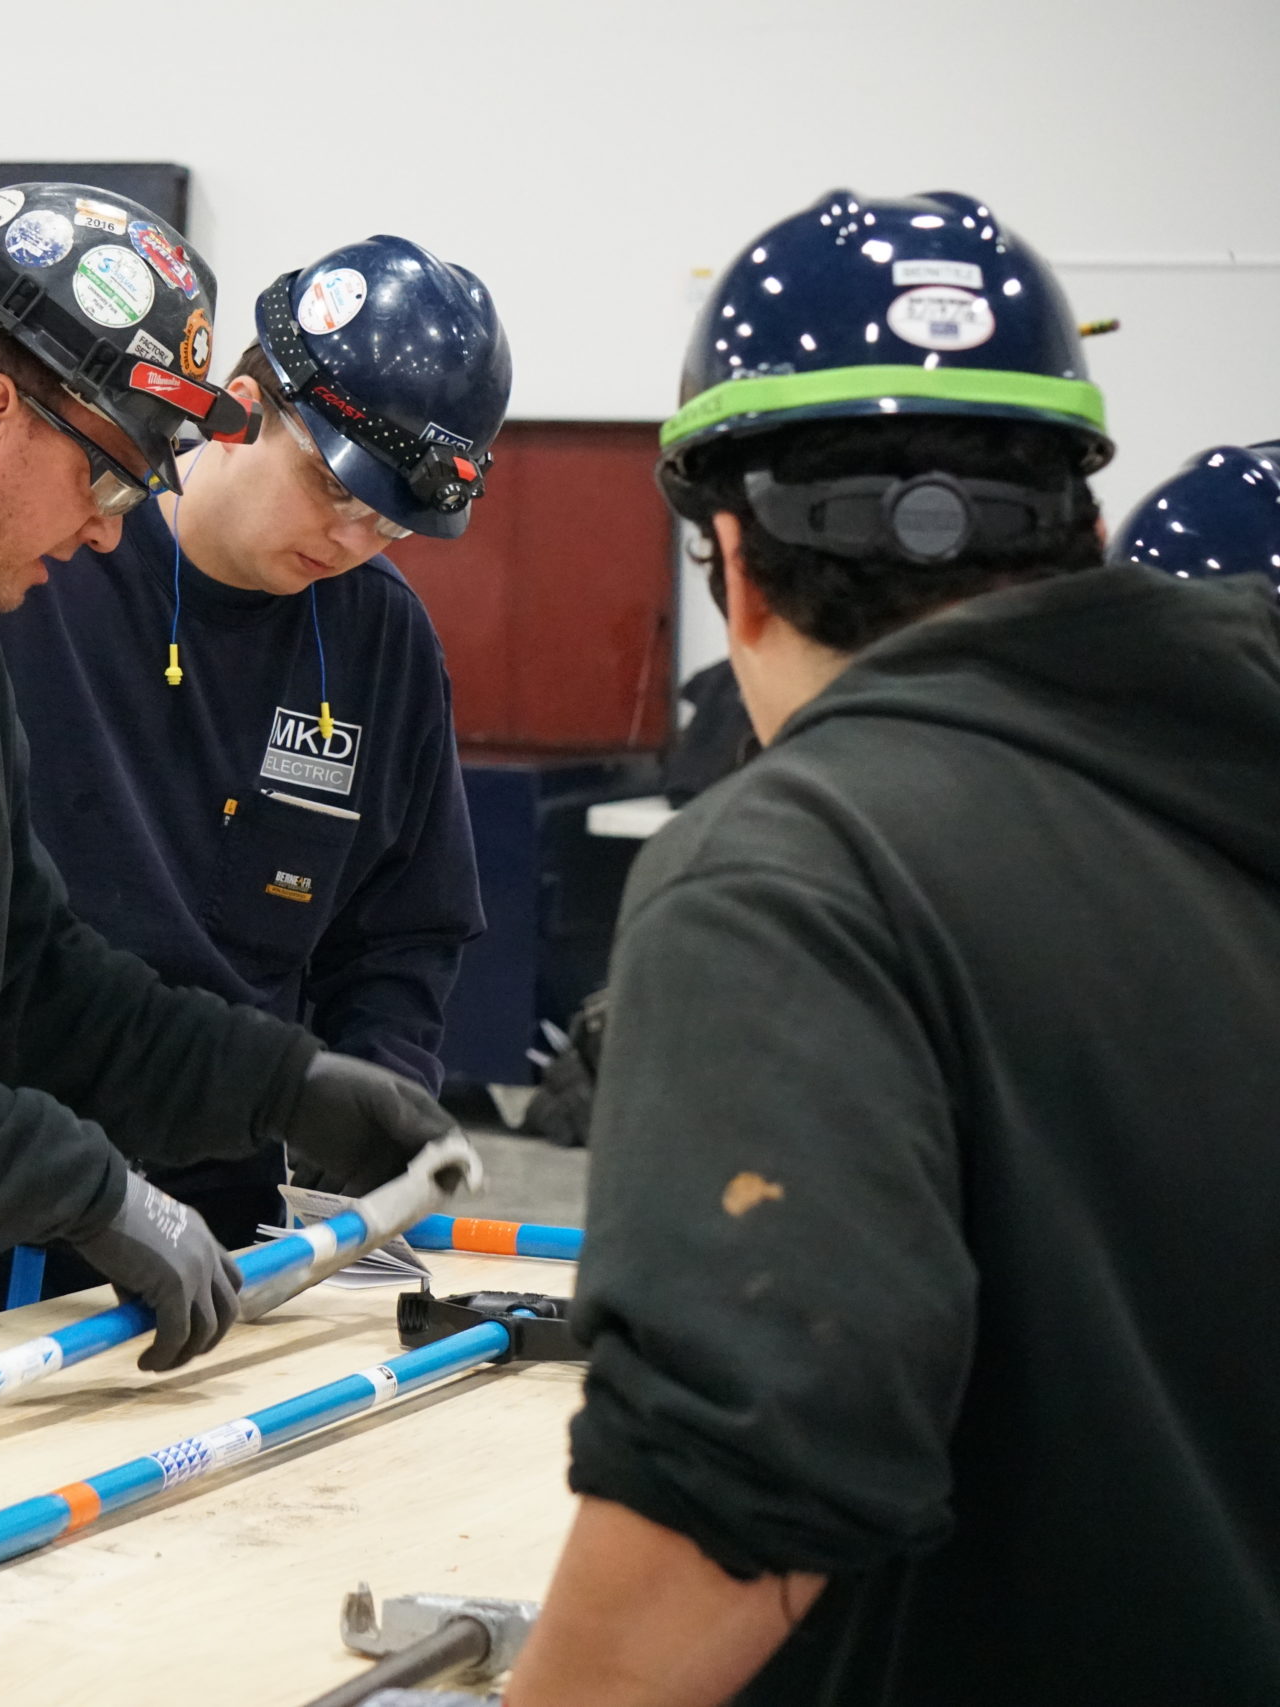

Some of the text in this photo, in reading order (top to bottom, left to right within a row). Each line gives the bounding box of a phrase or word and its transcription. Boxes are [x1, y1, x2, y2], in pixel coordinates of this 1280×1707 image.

[85, 216, 116, 232] 2016
[135, 344, 149, 359] SET
[139, 335, 169, 362] FACTORY
[313, 386, 367, 420] COAST
[271, 715, 354, 760] MKD
[265, 755, 345, 786] ELECTRIC
